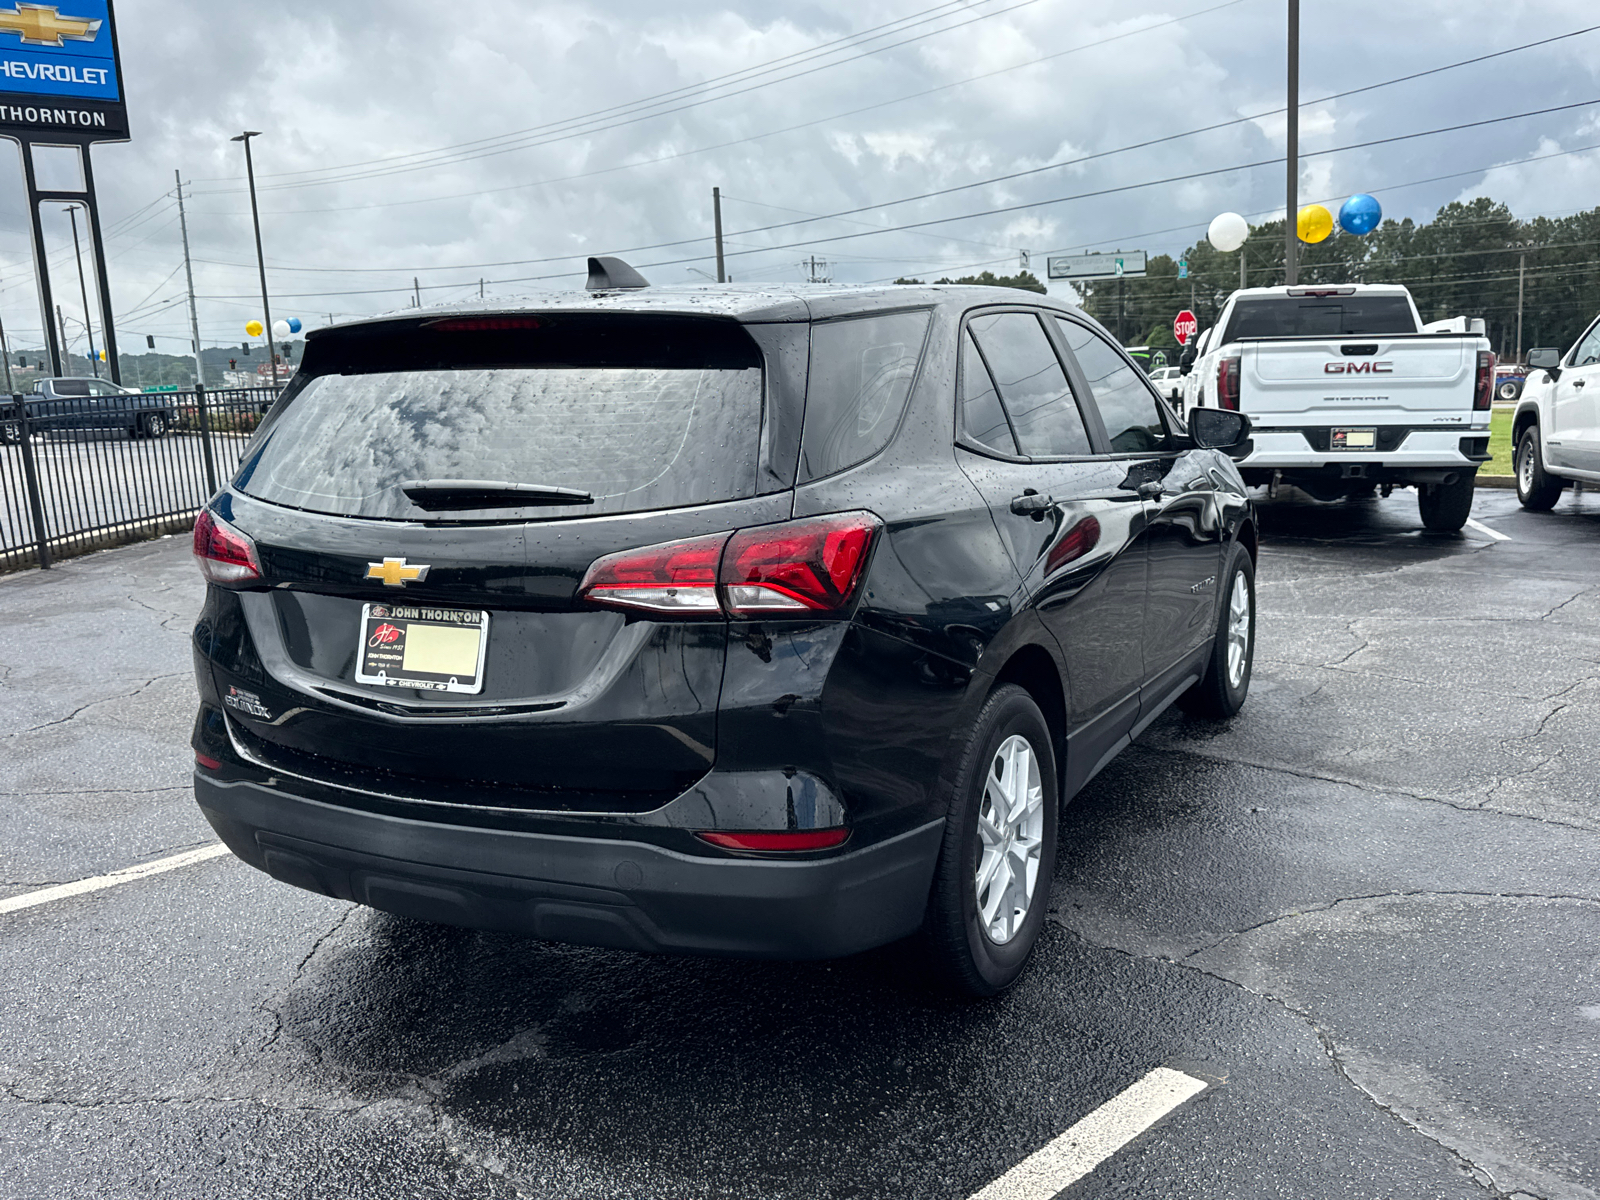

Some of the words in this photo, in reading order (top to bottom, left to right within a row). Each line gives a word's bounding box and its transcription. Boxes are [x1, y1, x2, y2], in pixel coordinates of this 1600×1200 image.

[0, 60, 108, 85] HEVROLET
[0, 105, 106, 126] THORNTON
[1175, 320, 1196, 336] STOP
[1324, 361, 1393, 375] GMC
[391, 607, 419, 619] JOHN
[421, 609, 481, 623] THORNTON
[398, 680, 435, 689] CHEVROLET
